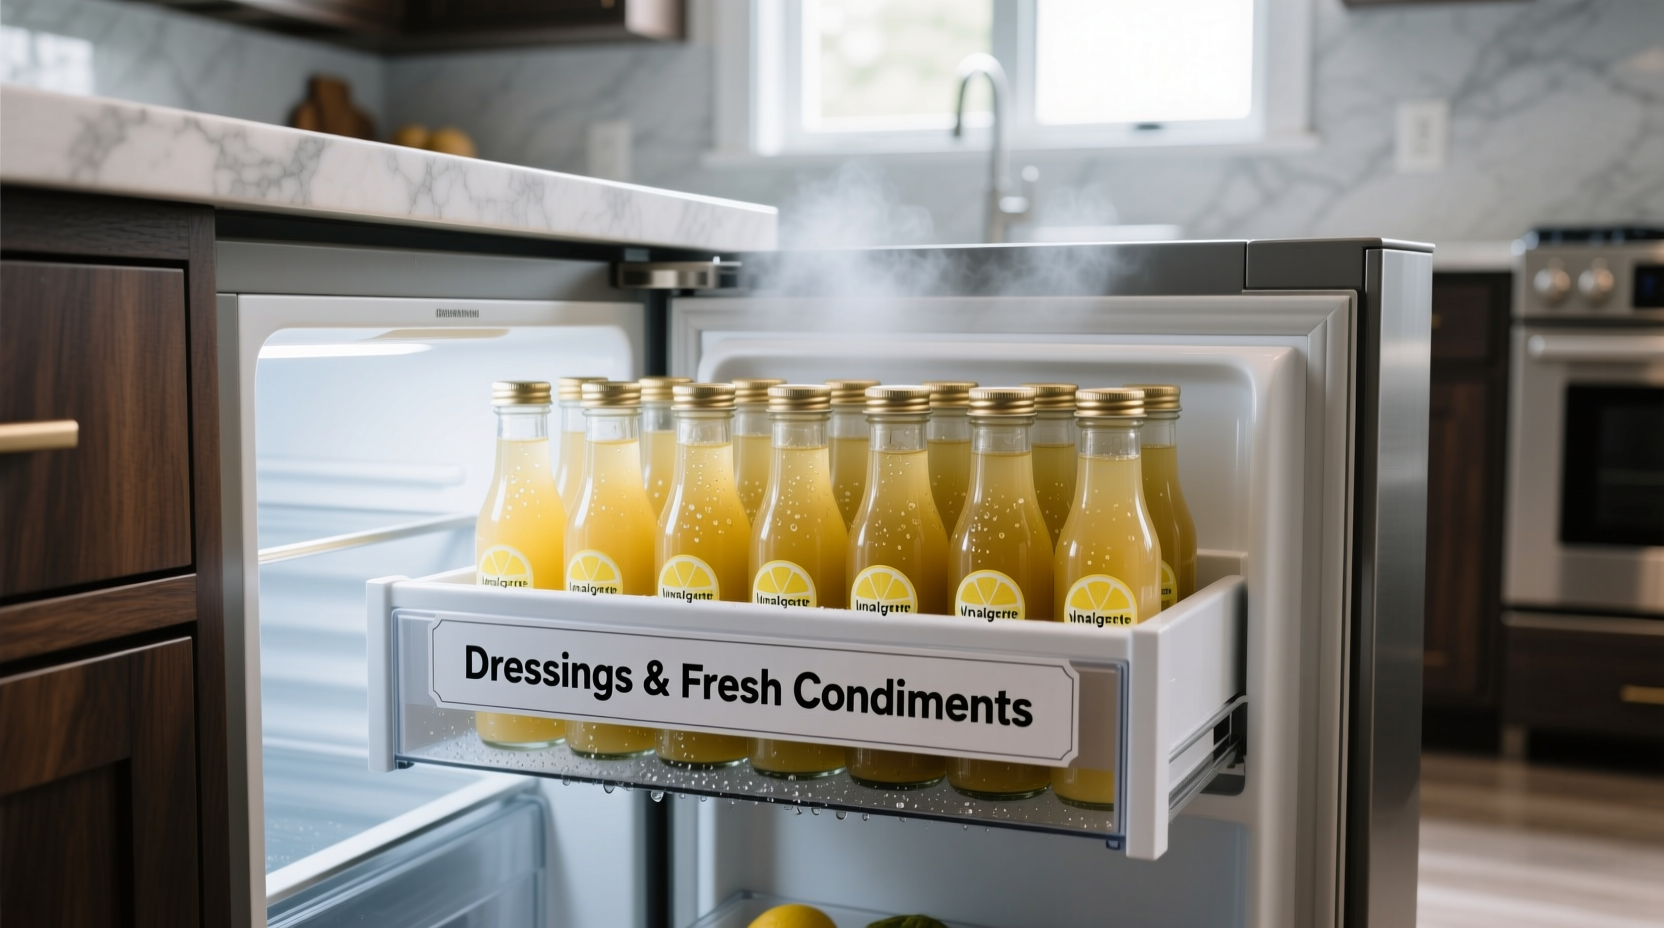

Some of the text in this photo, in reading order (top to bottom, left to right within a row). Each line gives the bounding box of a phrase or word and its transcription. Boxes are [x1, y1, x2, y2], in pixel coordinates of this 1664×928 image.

[465, 644, 1034, 728] Dressings & Fresh Condiments
